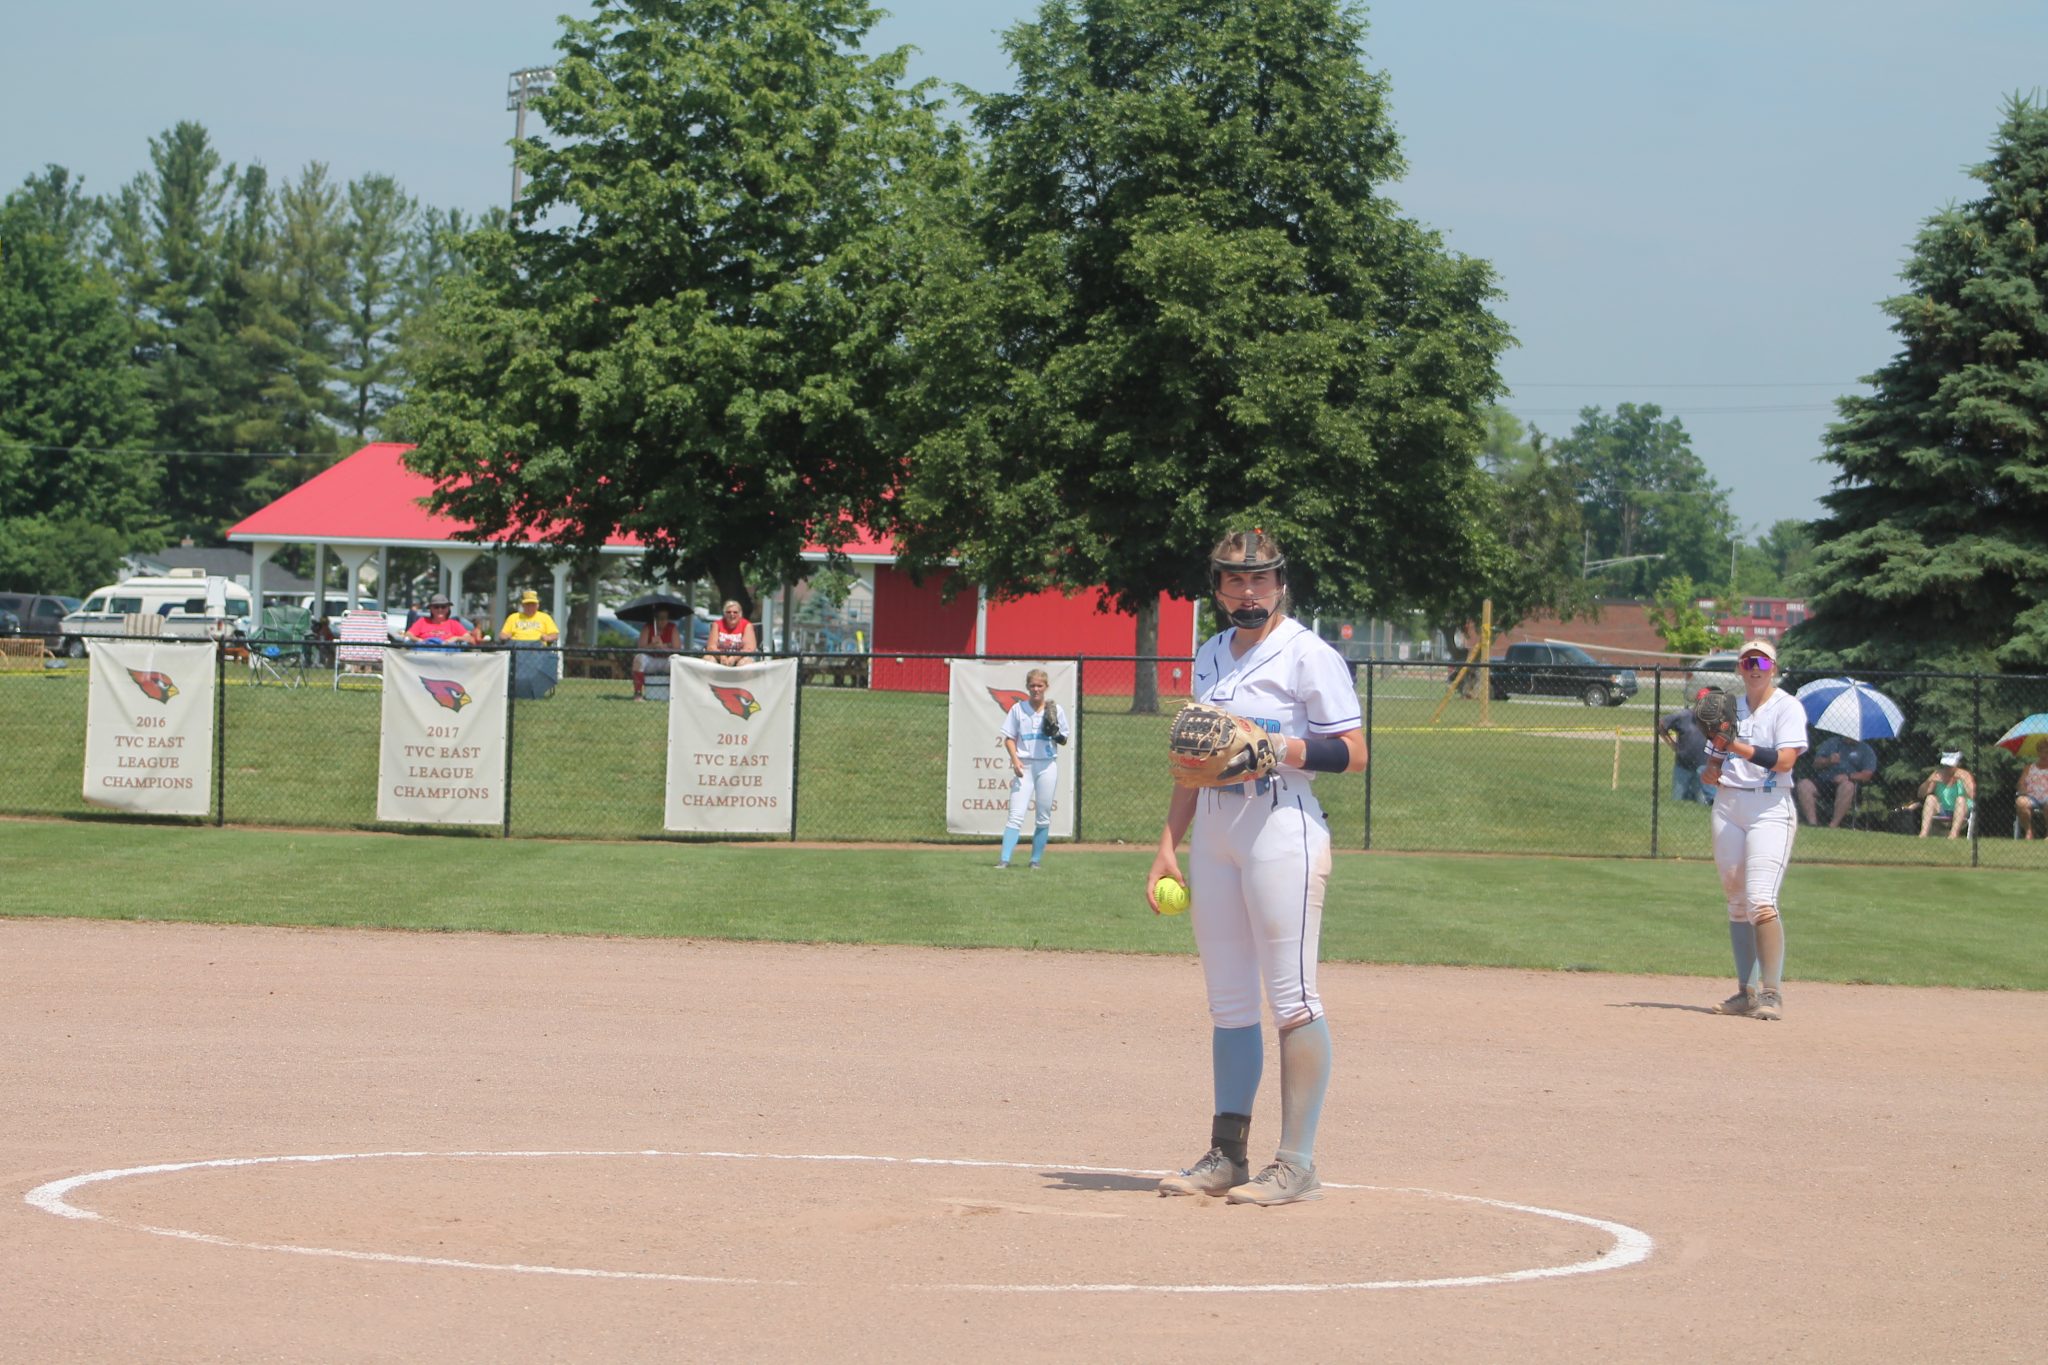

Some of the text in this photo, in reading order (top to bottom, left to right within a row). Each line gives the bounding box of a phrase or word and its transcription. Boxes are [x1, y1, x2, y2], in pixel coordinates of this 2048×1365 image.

[136, 716, 166, 728] 2016
[427, 726, 459, 738] 2017
[114, 735, 185, 748] TVC EAST
[717, 733, 748, 745] 2018
[404, 745, 481, 758] TVC EAST
[118, 756, 179, 768] LEAGUE
[693, 753, 769, 766] TVC EAST
[972, 757, 1004, 769] TVC
[409, 766, 474, 779] LEAGUE
[102, 776, 193, 789] CHAMPIONS
[698, 774, 763, 787] LEAGUE
[393, 785, 489, 799] CHAMPIONS
[682, 794, 777, 808] CHAMPIONS
[962, 799, 1058, 811] CHAMOS
